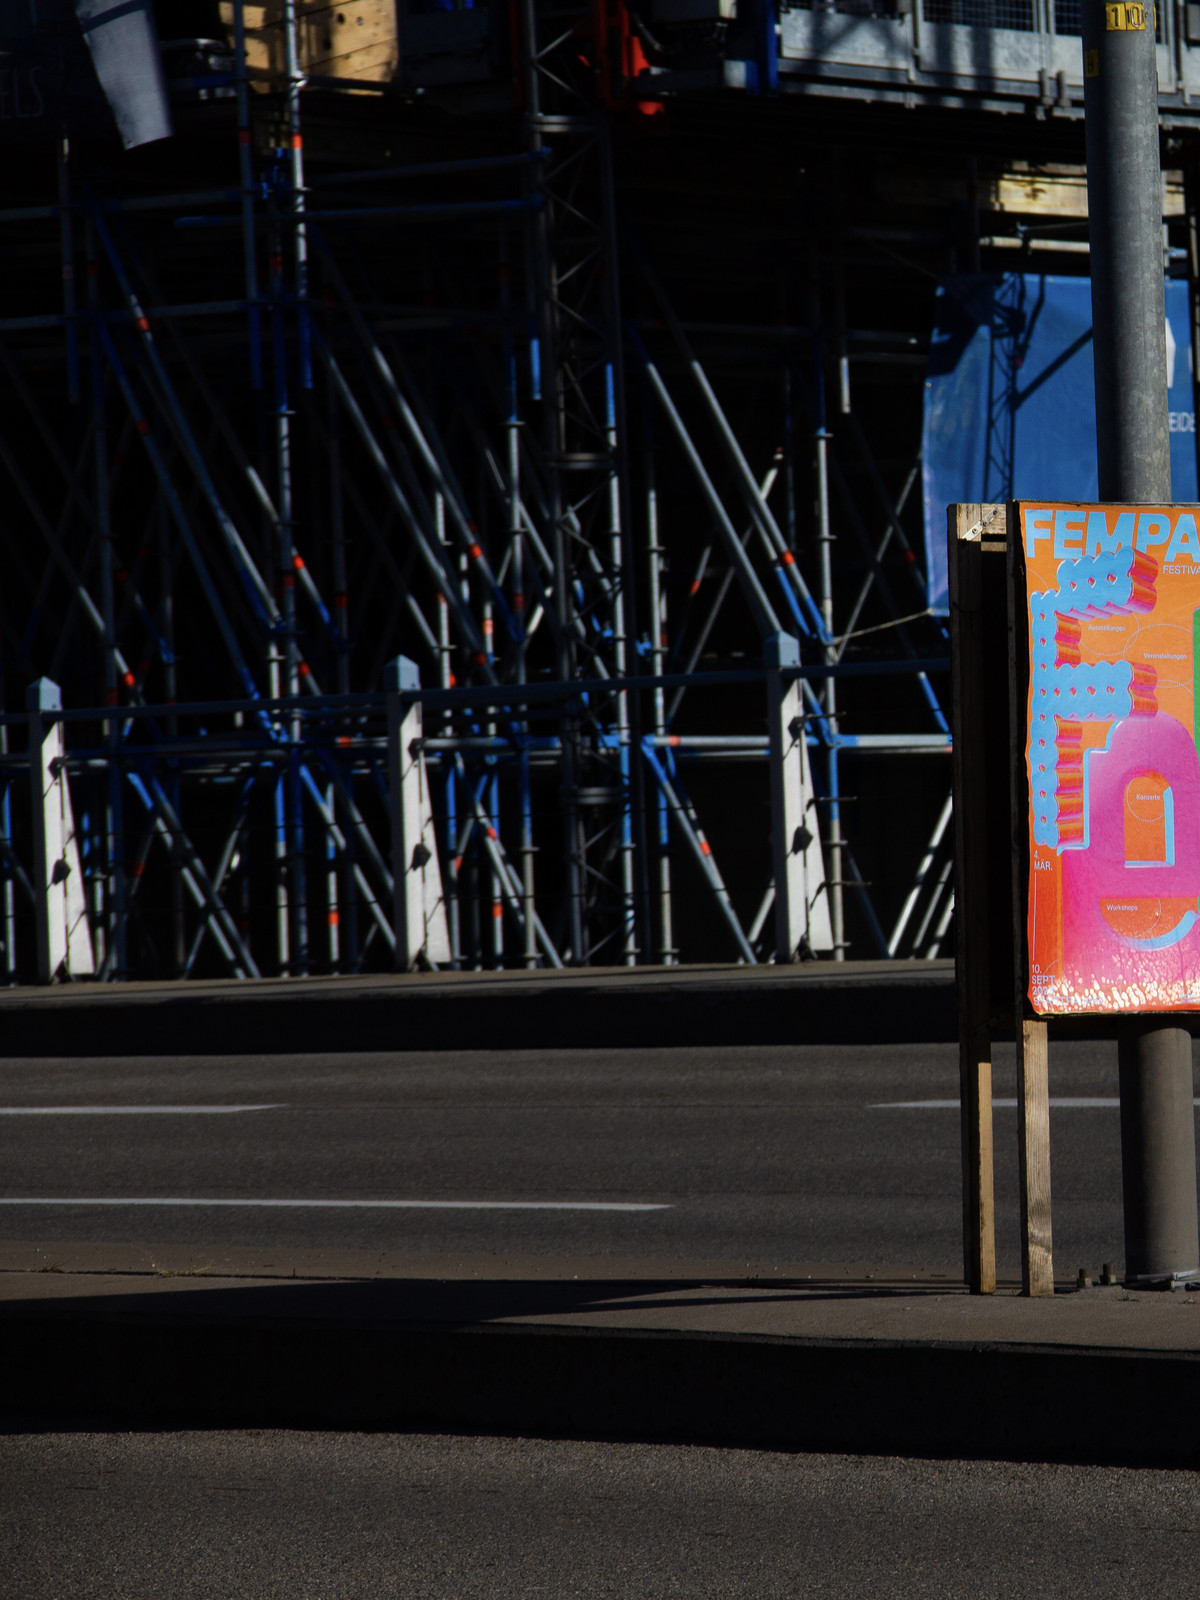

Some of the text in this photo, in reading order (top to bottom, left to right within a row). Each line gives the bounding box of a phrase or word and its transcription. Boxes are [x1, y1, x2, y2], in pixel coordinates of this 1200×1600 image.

[1088, 624, 1126, 632] Ausstellungen
[1034, 858, 1053, 871] MÄR.
[1032, 964, 1042, 974] 10.
